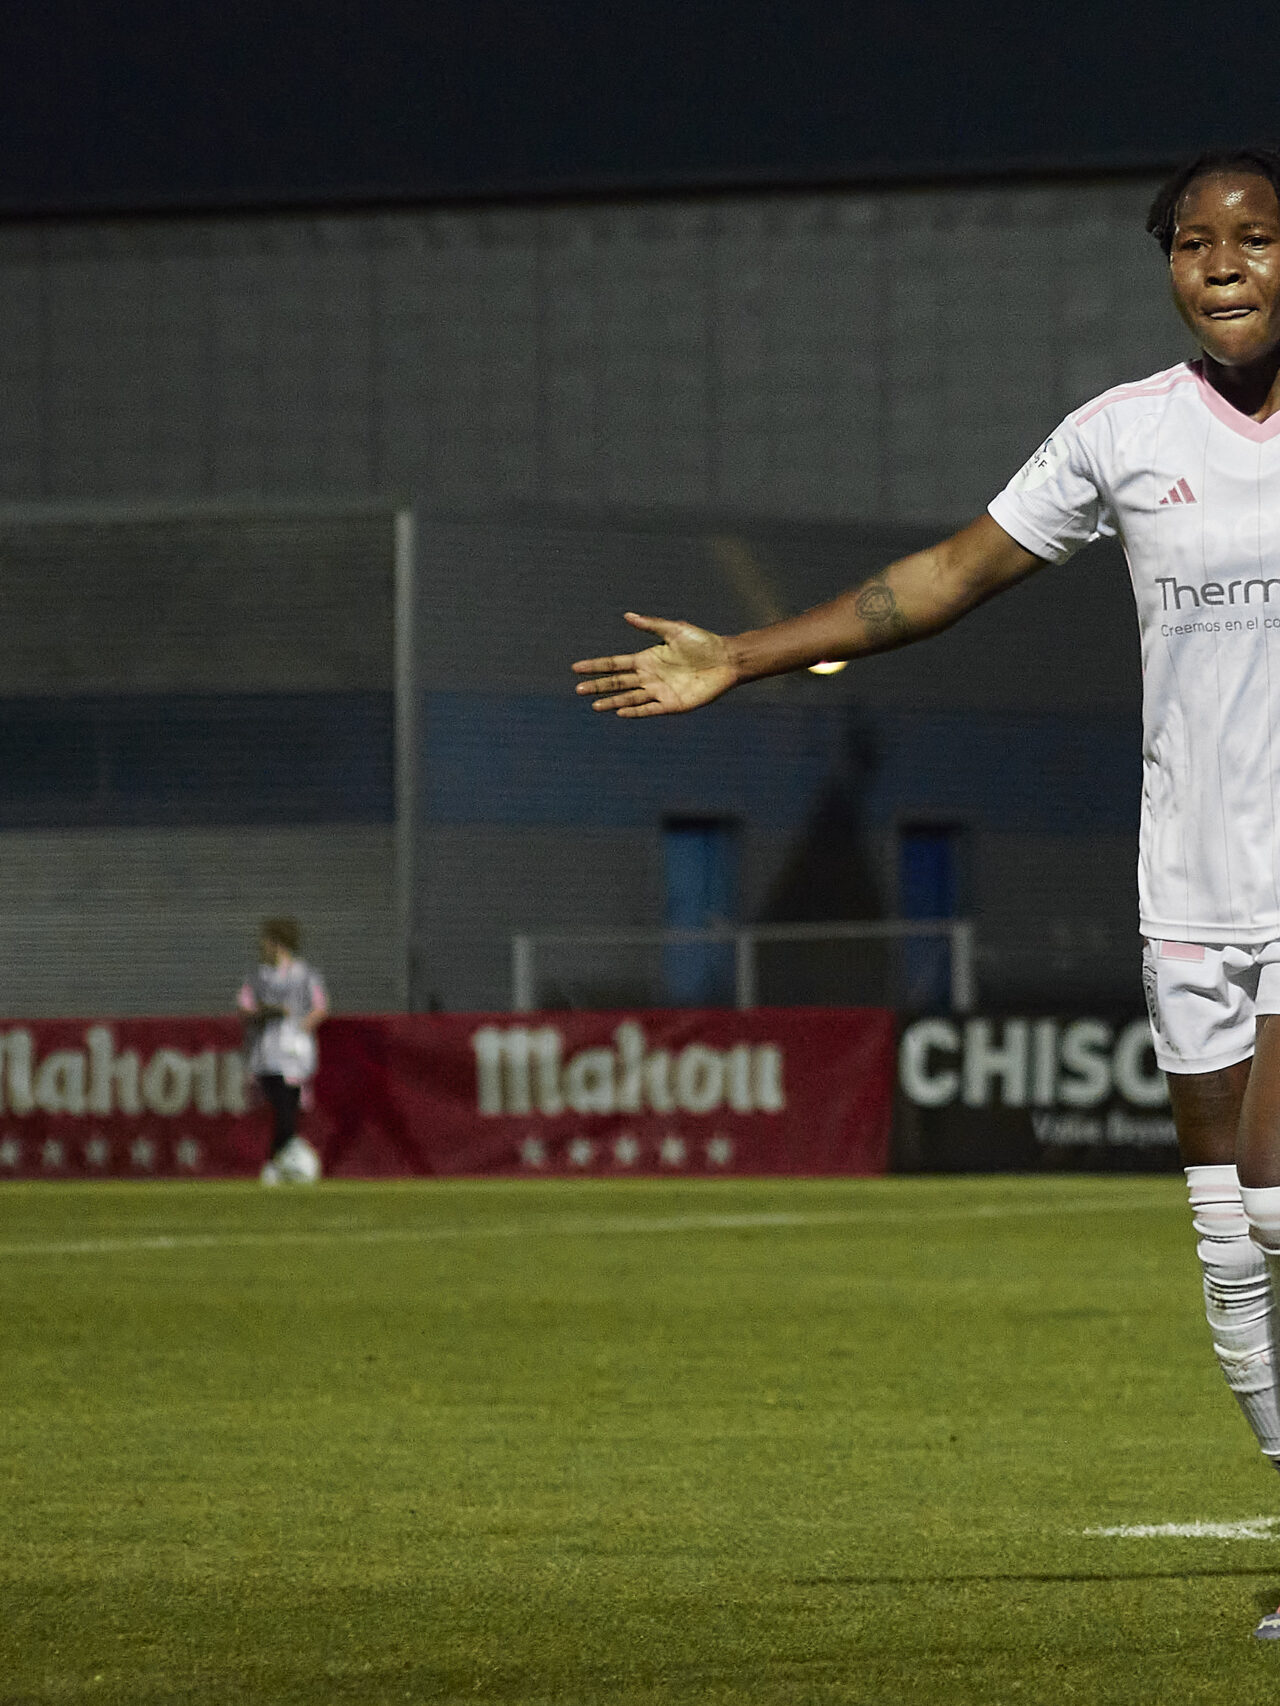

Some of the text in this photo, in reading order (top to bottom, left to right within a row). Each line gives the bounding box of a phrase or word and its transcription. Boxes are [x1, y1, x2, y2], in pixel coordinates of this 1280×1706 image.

[1160, 620, 1221, 638] Creemos
[1224, 620, 1243, 631] en
[1246, 616, 1259, 630] el
[473, 1019, 786, 1116] Mahou
